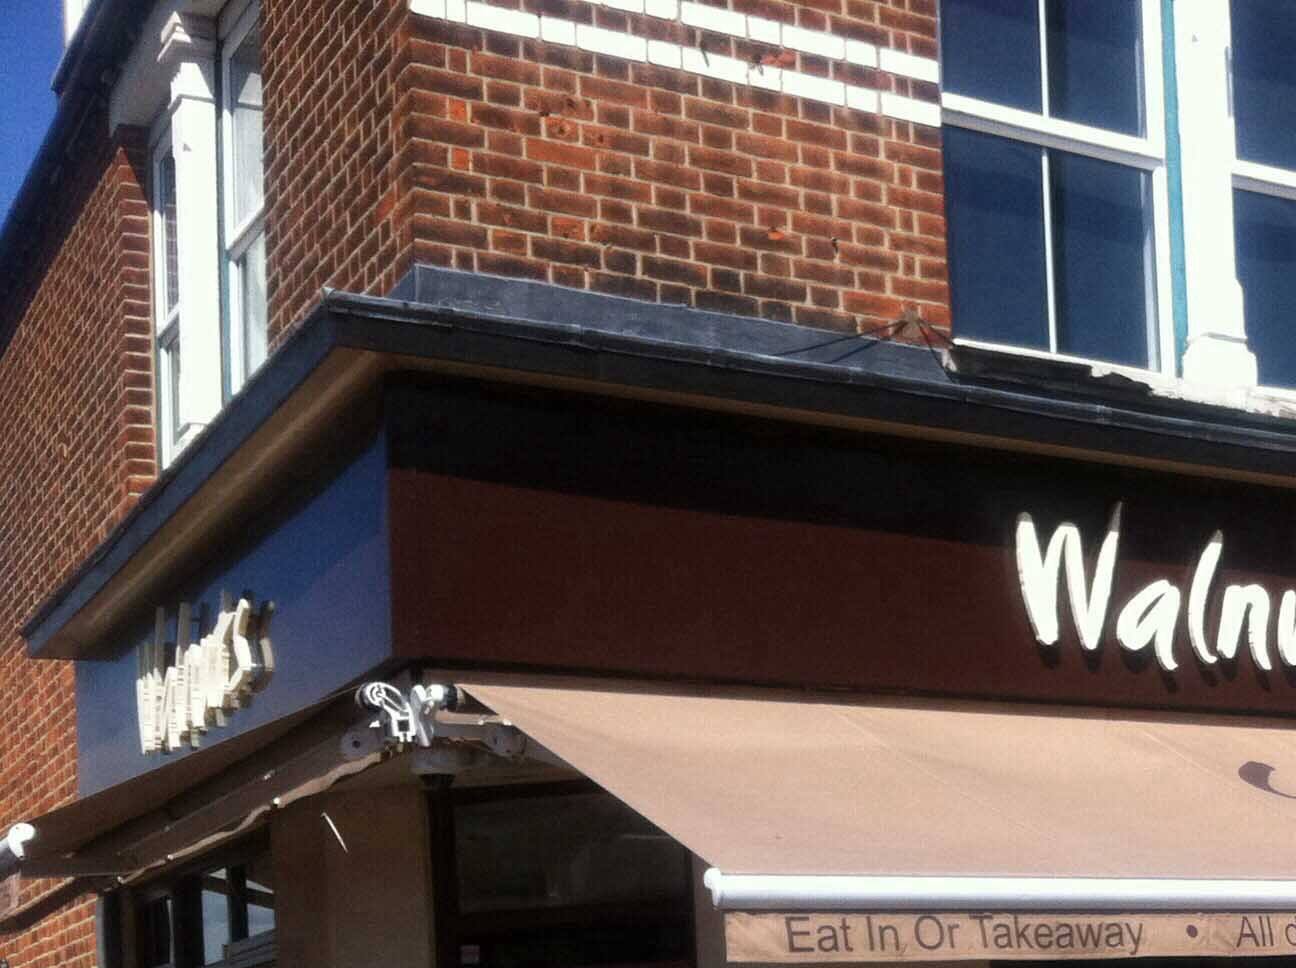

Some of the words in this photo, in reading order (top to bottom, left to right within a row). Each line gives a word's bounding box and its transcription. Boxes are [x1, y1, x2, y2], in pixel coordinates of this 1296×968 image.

[786, 914, 853, 954] Eat
[868, 914, 899, 953] In
[914, 914, 960, 953] Or
[971, 913, 1145, 956] Takeaway
[1236, 914, 1275, 949] All
